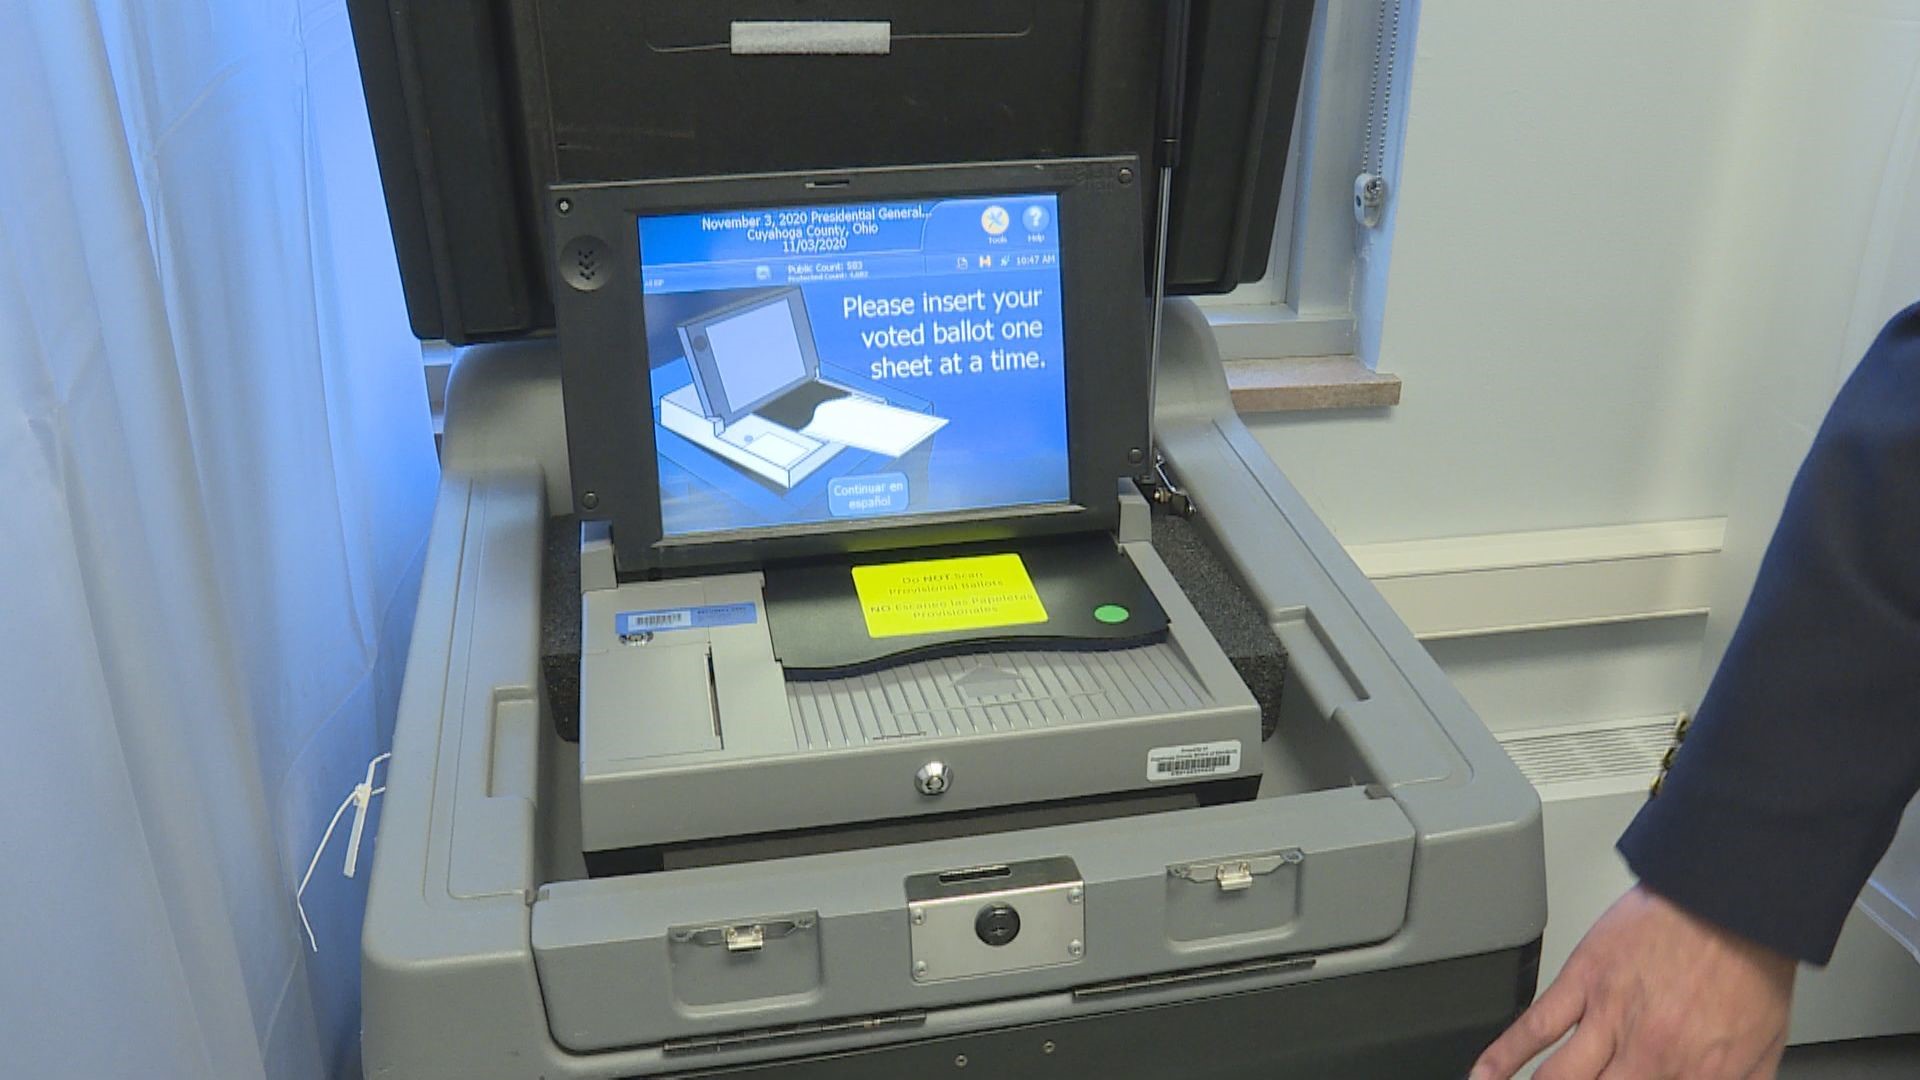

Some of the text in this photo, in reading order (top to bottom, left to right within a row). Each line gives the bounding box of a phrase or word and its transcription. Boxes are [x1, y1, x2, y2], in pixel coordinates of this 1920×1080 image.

[702, 206, 932, 231] November 3, 2020 Presidential General...
[747, 222, 879, 242] Cuyahoga County, Ohio
[989, 234, 1008, 244] Tools
[783, 237, 847, 254] 11/03/2020
[788, 264, 813, 275] Public
[816, 262, 843, 273] Count:
[1017, 254, 1056, 266] 10:47 AM
[843, 289, 1043, 319] Please insert your
[861, 319, 1043, 348] voted ballot one
[871, 349, 1046, 380] sheet at a time.
[834, 482, 904, 496] Continuar en
[848, 496, 891, 510] español
[902, 571, 984, 584] Do NOT Scan
[889, 579, 1004, 596] Provisional Ballots
[870, 605, 891, 613] NO
[972, 593, 1034, 607] Papeletas
[913, 605, 999, 619] Provisionales
